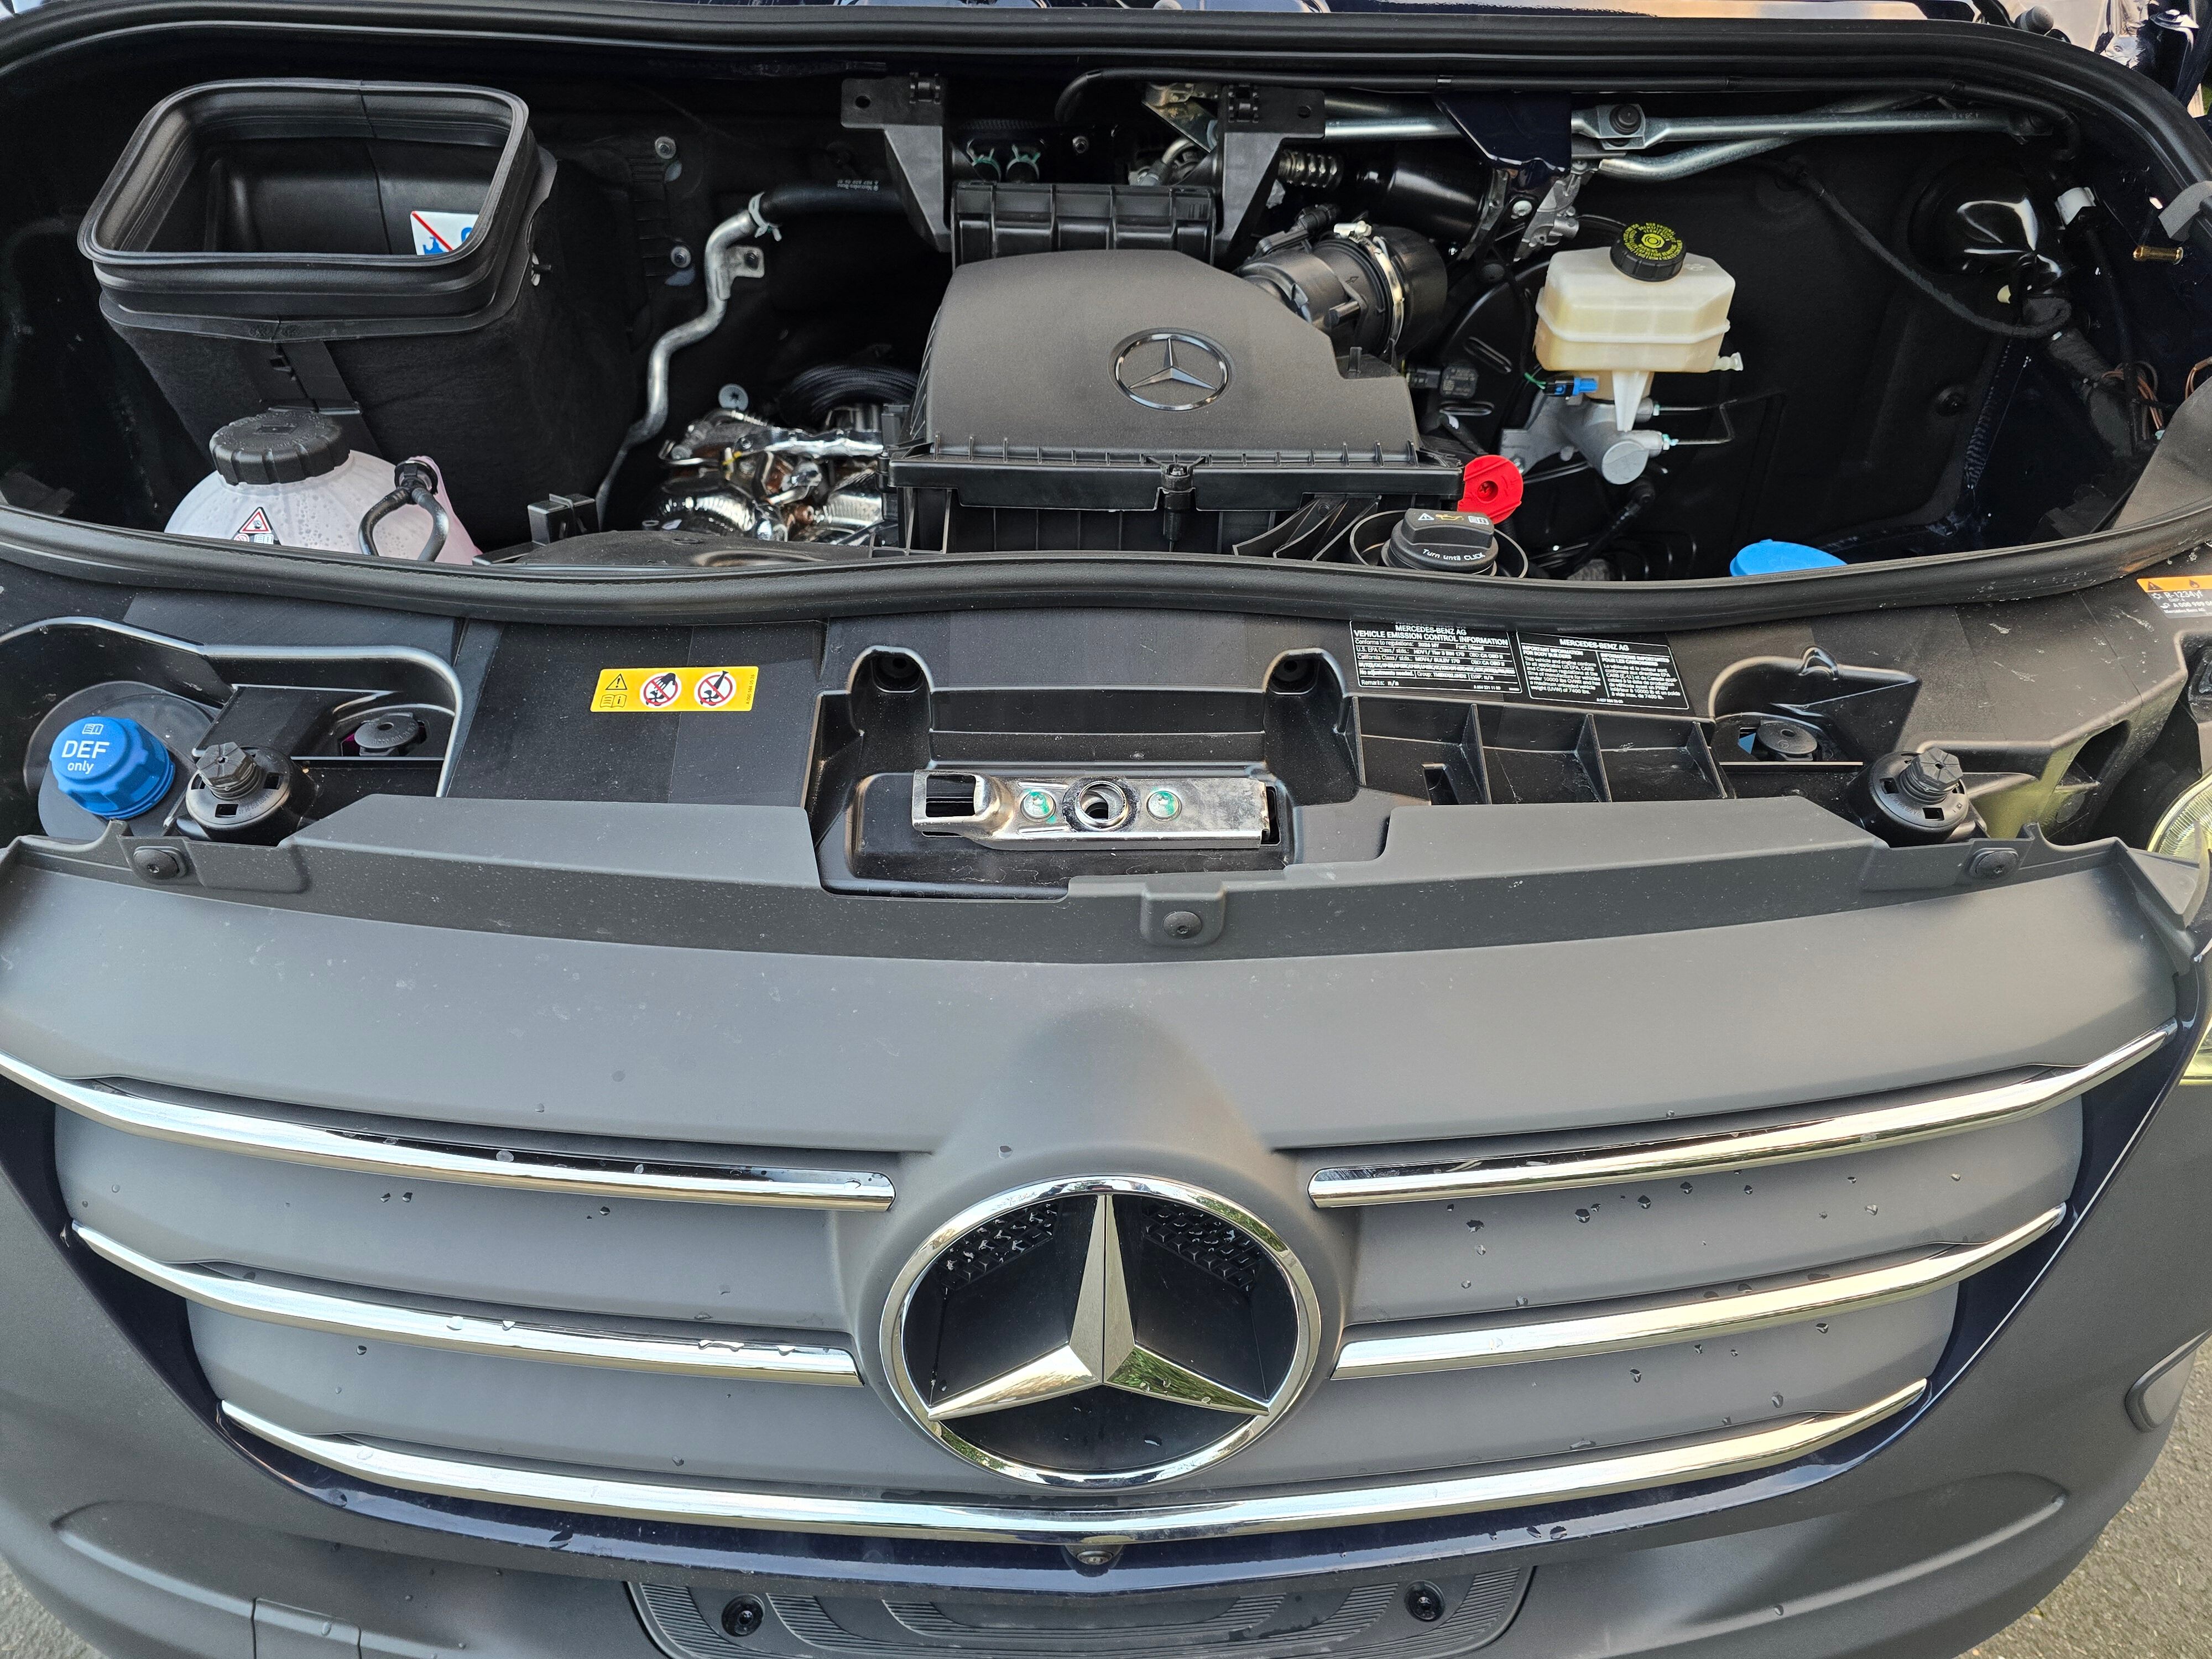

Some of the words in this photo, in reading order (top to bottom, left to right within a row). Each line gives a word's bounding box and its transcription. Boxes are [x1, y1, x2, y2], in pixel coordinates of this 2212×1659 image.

[1423, 549, 1441, 559] Turn
[1464, 552, 1486, 561] CLICK
[2163, 590, 2203, 599] R-1234yf
[1395, 624, 1455, 635] MERCEDES-BENZ
[1459, 637, 1508, 645] INFORMATION
[1559, 639, 1618, 650] MERCEDES-BENZ
[61, 740, 110, 759] DEF
[67, 760, 94, 774] only
